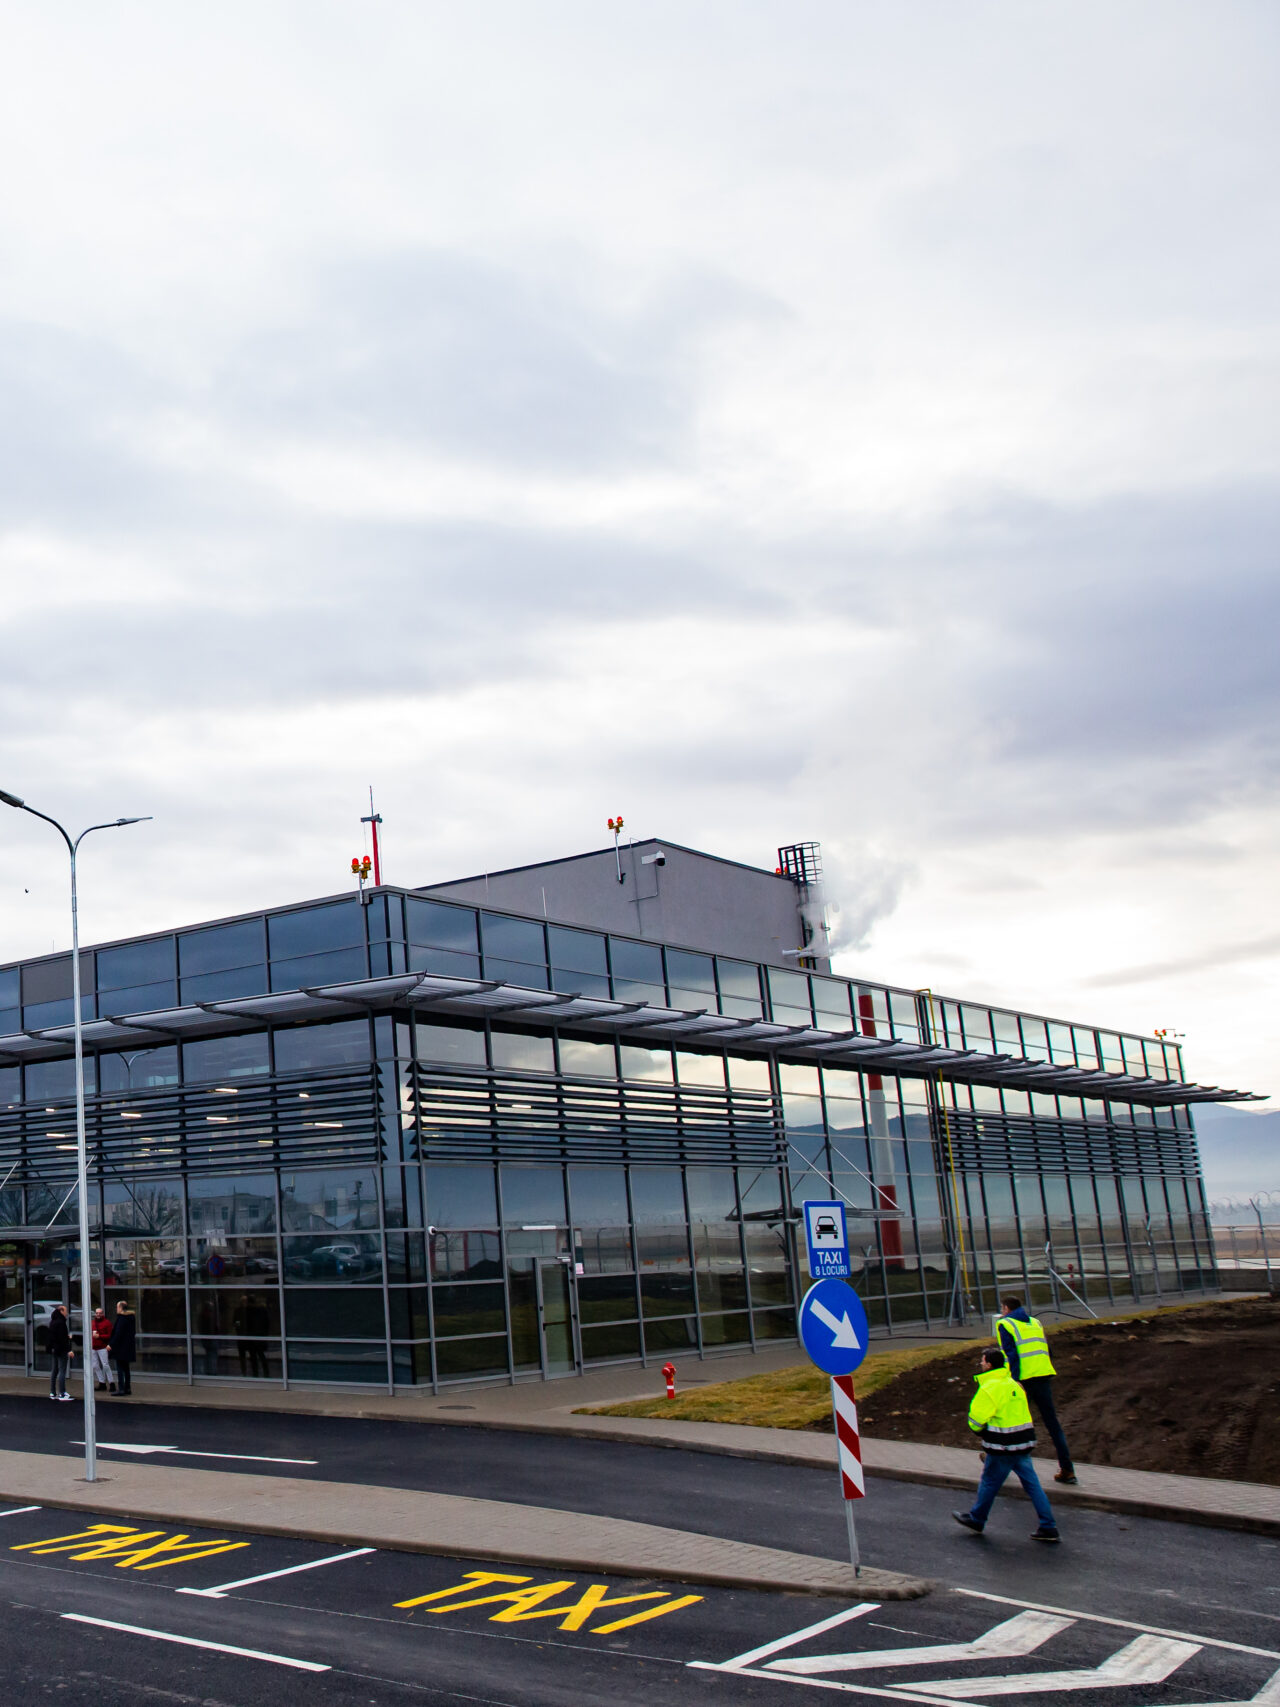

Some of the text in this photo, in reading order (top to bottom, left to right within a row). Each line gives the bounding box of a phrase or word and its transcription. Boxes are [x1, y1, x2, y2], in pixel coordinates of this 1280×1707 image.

[815, 1265, 848, 1276] 8 LOCURI
[817, 1251, 843, 1265] TAXI
[9, 1524, 252, 1570] TAXI
[392, 1571, 705, 1634] TAXI
